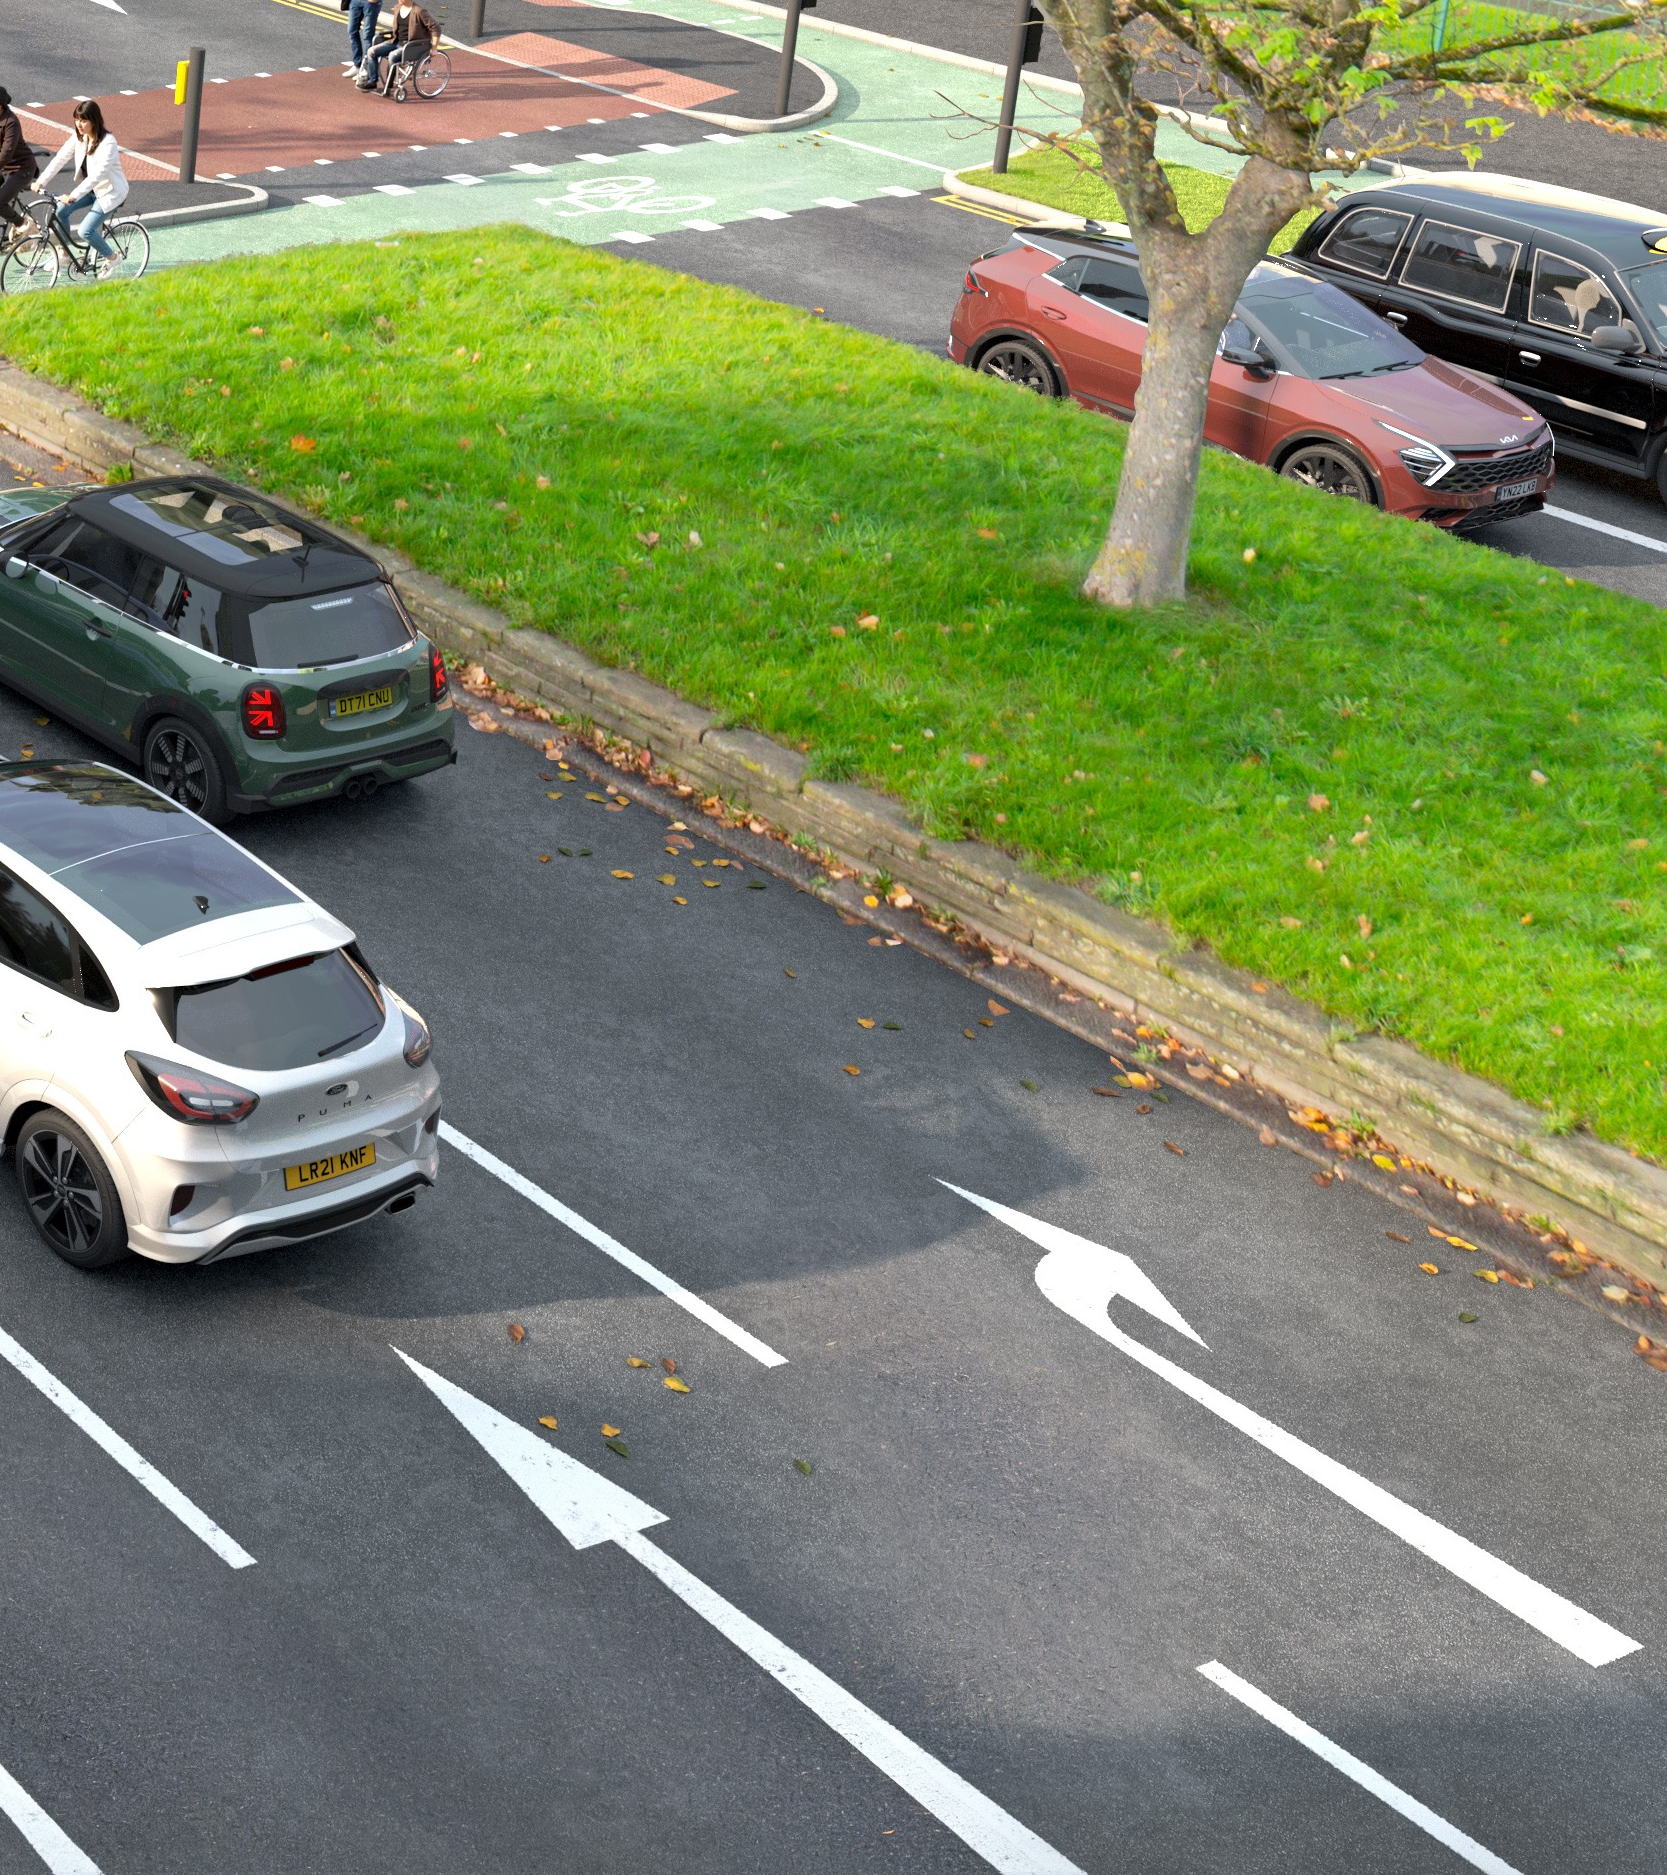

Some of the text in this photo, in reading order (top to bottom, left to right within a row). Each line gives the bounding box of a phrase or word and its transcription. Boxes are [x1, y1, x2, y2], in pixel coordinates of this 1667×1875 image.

[1503, 480, 1536, 498] YN22 LKB
[340, 690, 390, 713] DT71 CNU
[298, 1094, 372, 1123] PUMA
[298, 1145, 367, 1183] LR21 KNF
